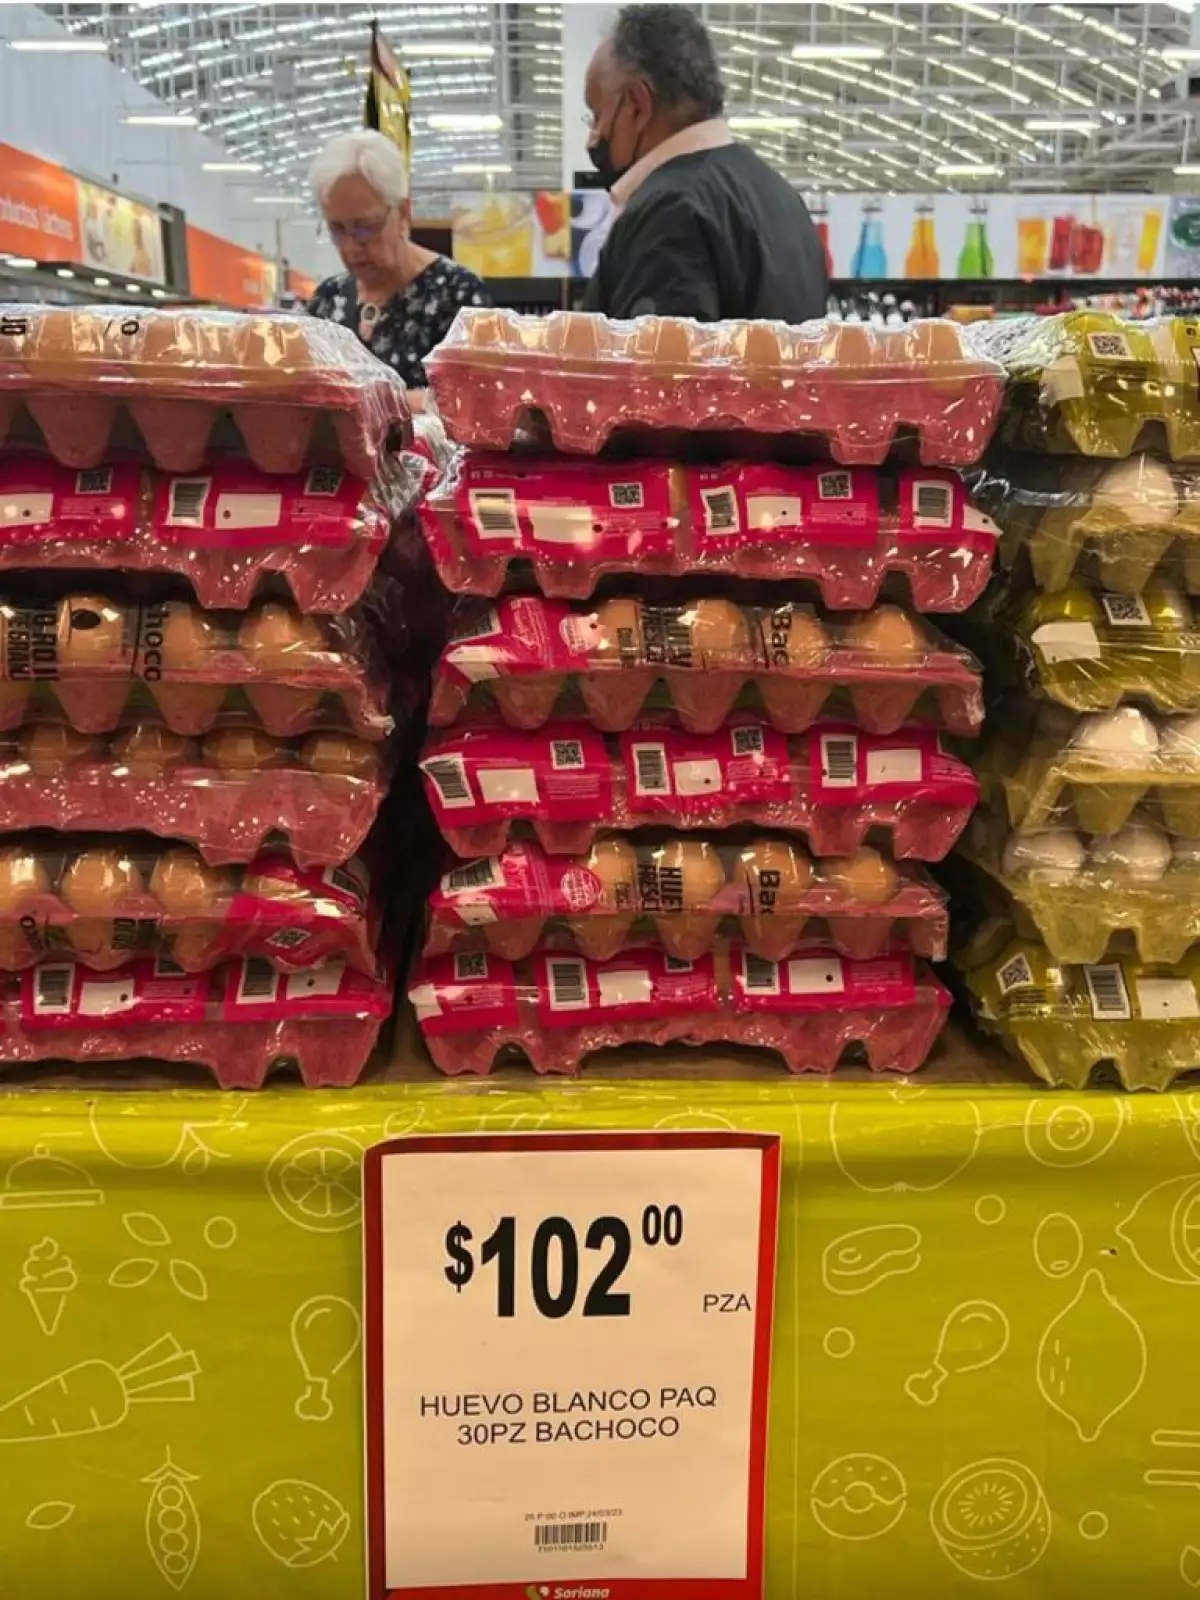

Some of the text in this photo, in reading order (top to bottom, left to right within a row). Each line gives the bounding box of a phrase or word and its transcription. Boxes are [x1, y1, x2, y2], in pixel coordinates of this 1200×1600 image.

[444, 1204, 683, 1319] $102 00
[702, 1293, 751, 1313] PZA
[420, 1385, 718, 1417] HUEVO BLANCO PAQ
[457, 1416, 680, 1446] 30PZ BACHOCO
[553, 1585, 610, 1600] Soriana
